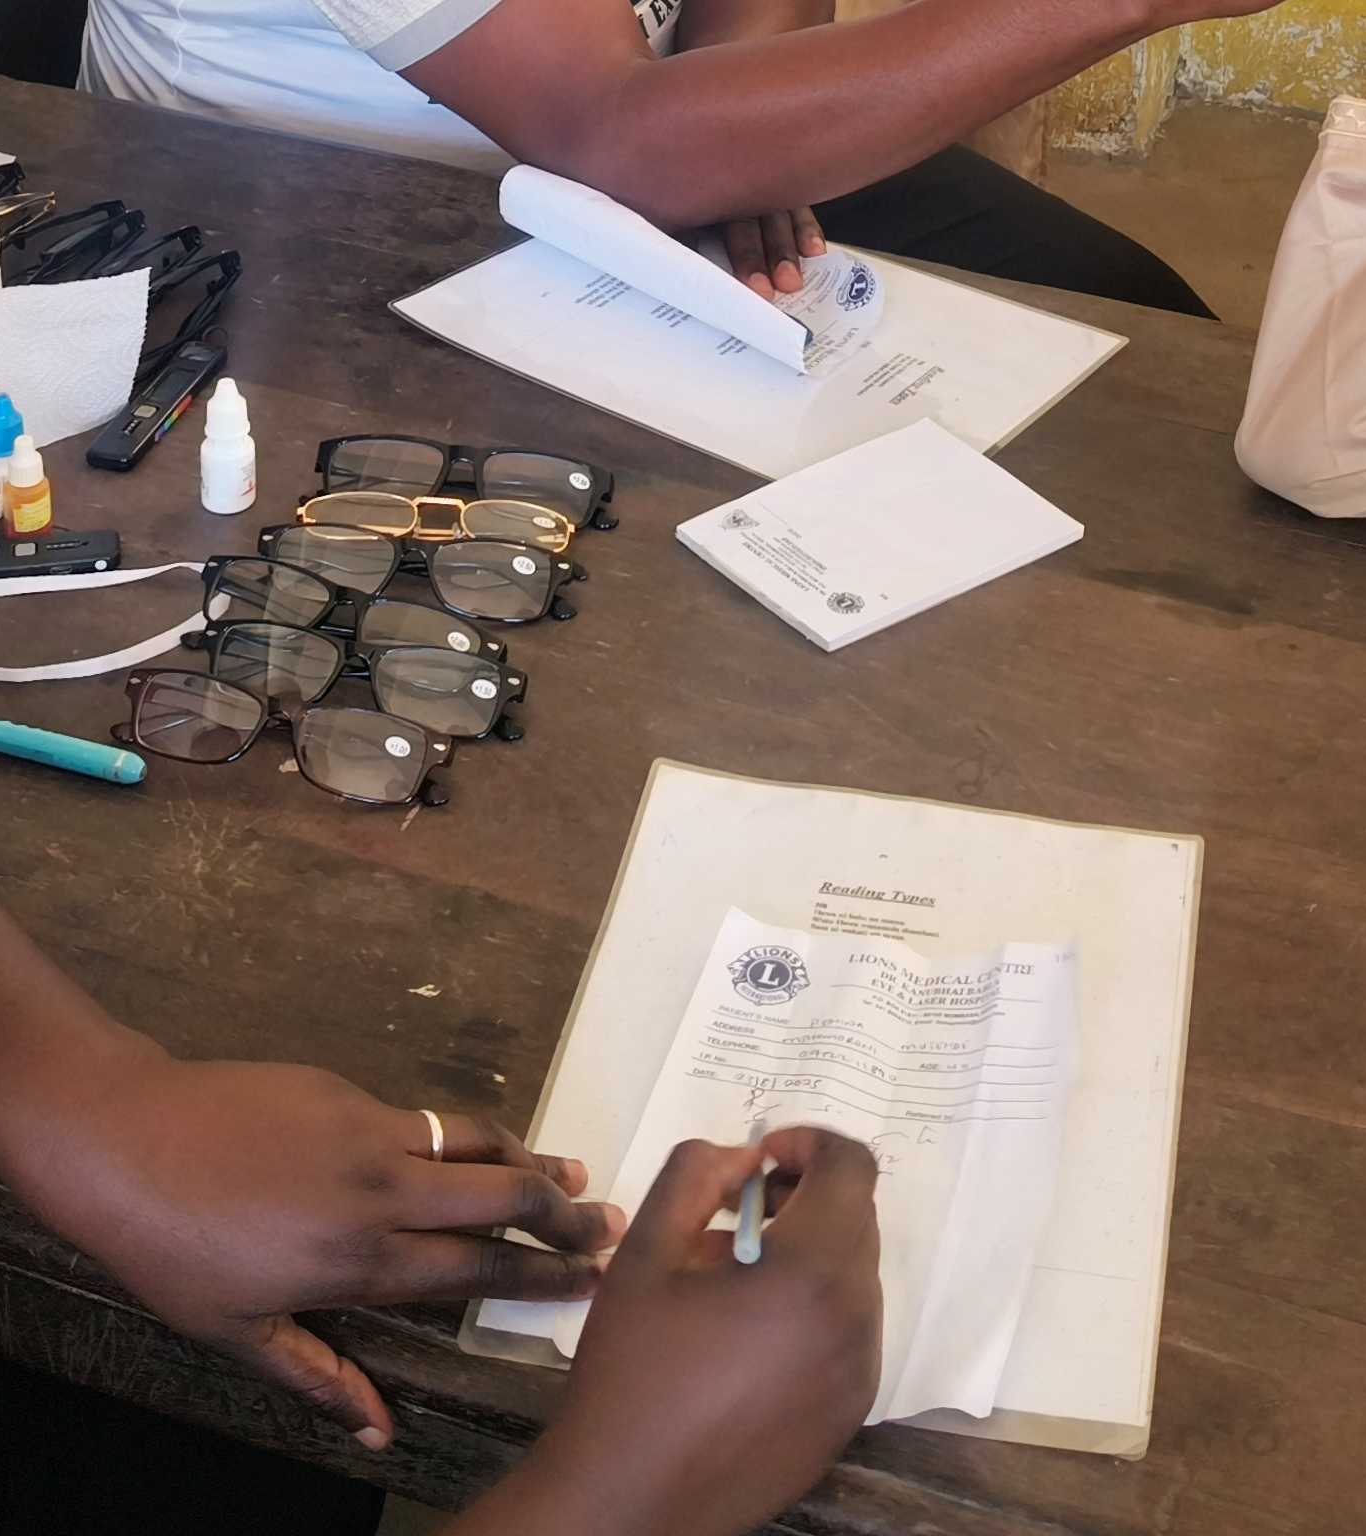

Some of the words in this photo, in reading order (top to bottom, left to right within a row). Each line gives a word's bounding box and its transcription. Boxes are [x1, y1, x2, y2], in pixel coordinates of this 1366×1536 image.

[819, 882, 885, 900] Reading
[892, 890, 936, 905] Types
[753, 947, 800, 965] LIONS
[757, 962, 780, 986] L
[849, 953, 898, 972] LIONS
[901, 967, 973, 986] MEDICAL
[871, 979, 895, 993] EYE
[909, 996, 947, 1006] LASER
[713, 1021, 755, 1034] ADDRESS
[707, 1036, 760, 1050] TELEPHONE
